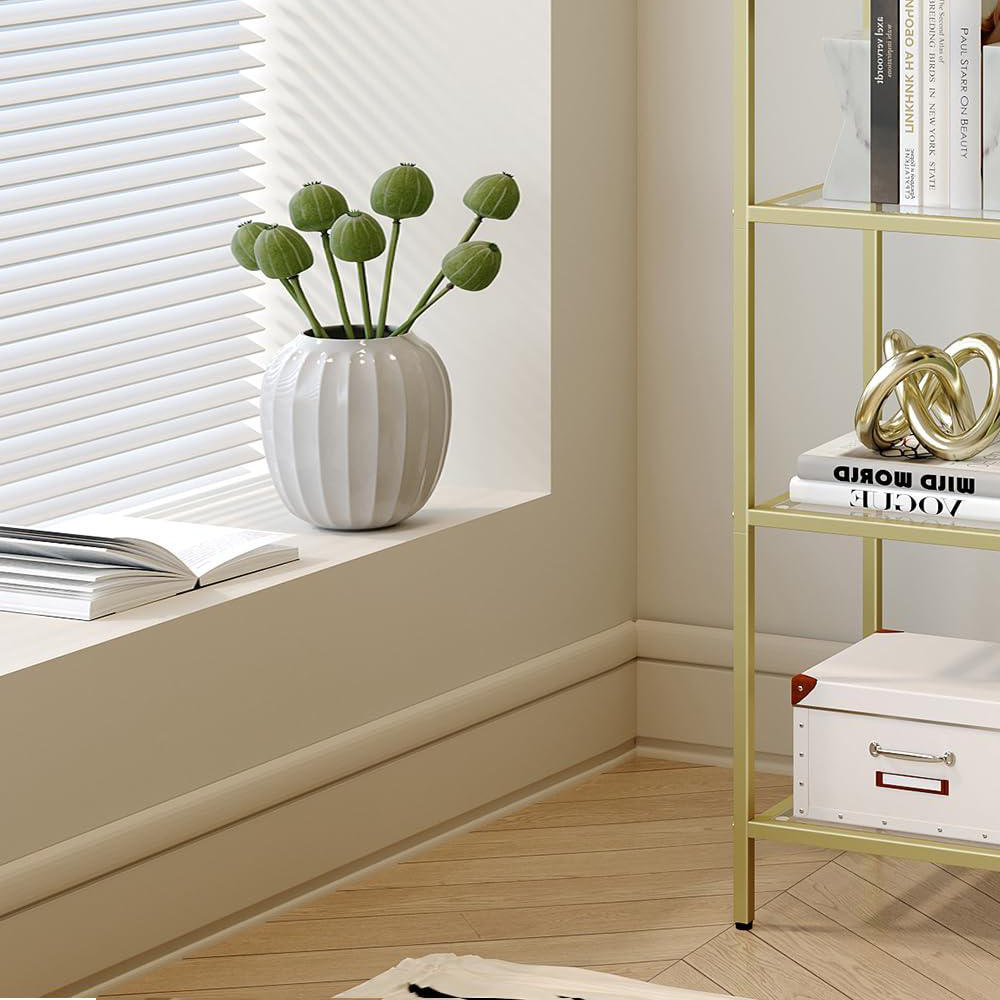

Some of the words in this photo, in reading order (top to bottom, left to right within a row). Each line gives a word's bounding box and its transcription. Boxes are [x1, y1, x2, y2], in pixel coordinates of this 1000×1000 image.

[960, 27, 969, 56] PAUL
[928, 53, 936, 83] BIRDS
[938, 55, 945, 64] of
[960, 58, 969, 92] STARR
[928, 87, 936, 98] IN
[960, 95, 969, 114] ON
[928, 103, 936, 127] NEW
[928, 128, 936, 156] YORK
[960, 118, 969, 160] BEAUTY
[928, 161, 936, 191] STATE
